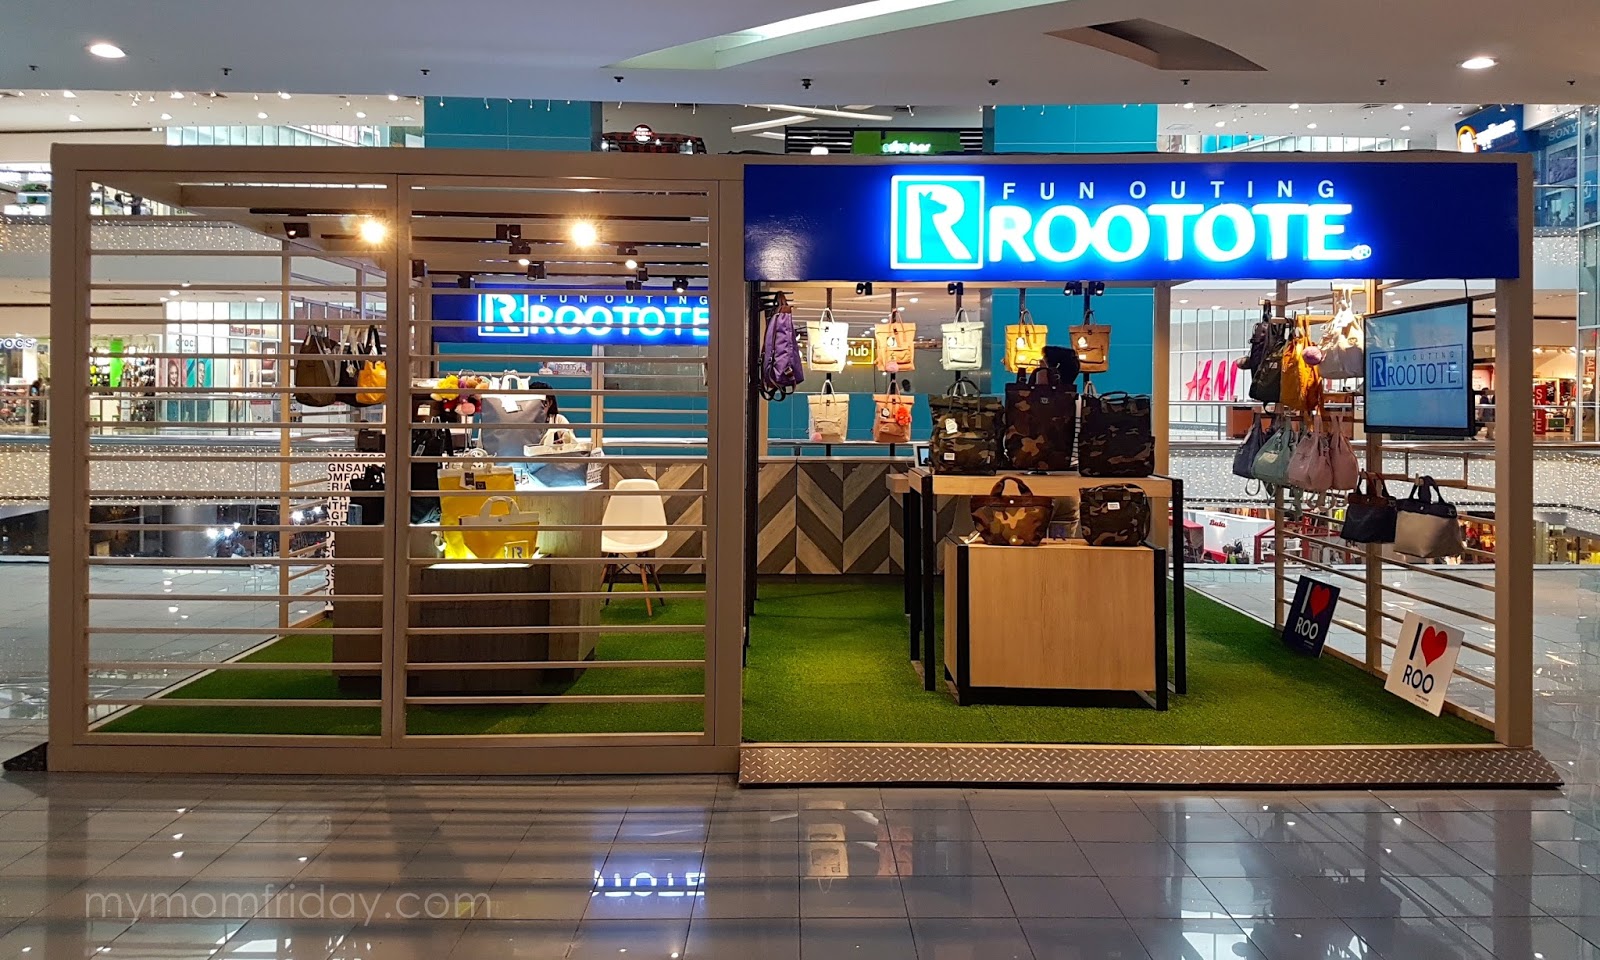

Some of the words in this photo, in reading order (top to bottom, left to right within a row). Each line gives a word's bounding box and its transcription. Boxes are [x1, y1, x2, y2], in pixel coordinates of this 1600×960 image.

[1548, 121, 1581, 141] SONY
[1002, 181, 1094, 200] FUN
[1128, 179, 1335, 199] OUTING
[988, 203, 1353, 263] ROOTOTE
[539, 295, 588, 304] FUN
[604, 295, 709, 305] OUTING
[530, 305, 710, 336] ROOTOTE
[1412, 350, 1455, 361] OUTING
[1185, 359, 1239, 401] H&M
[1387, 361, 1457, 386] ROOTOTE
[1294, 616, 1319, 640] ROO
[1409, 622, 1423, 661] I
[1402, 664, 1434, 694] ROO
